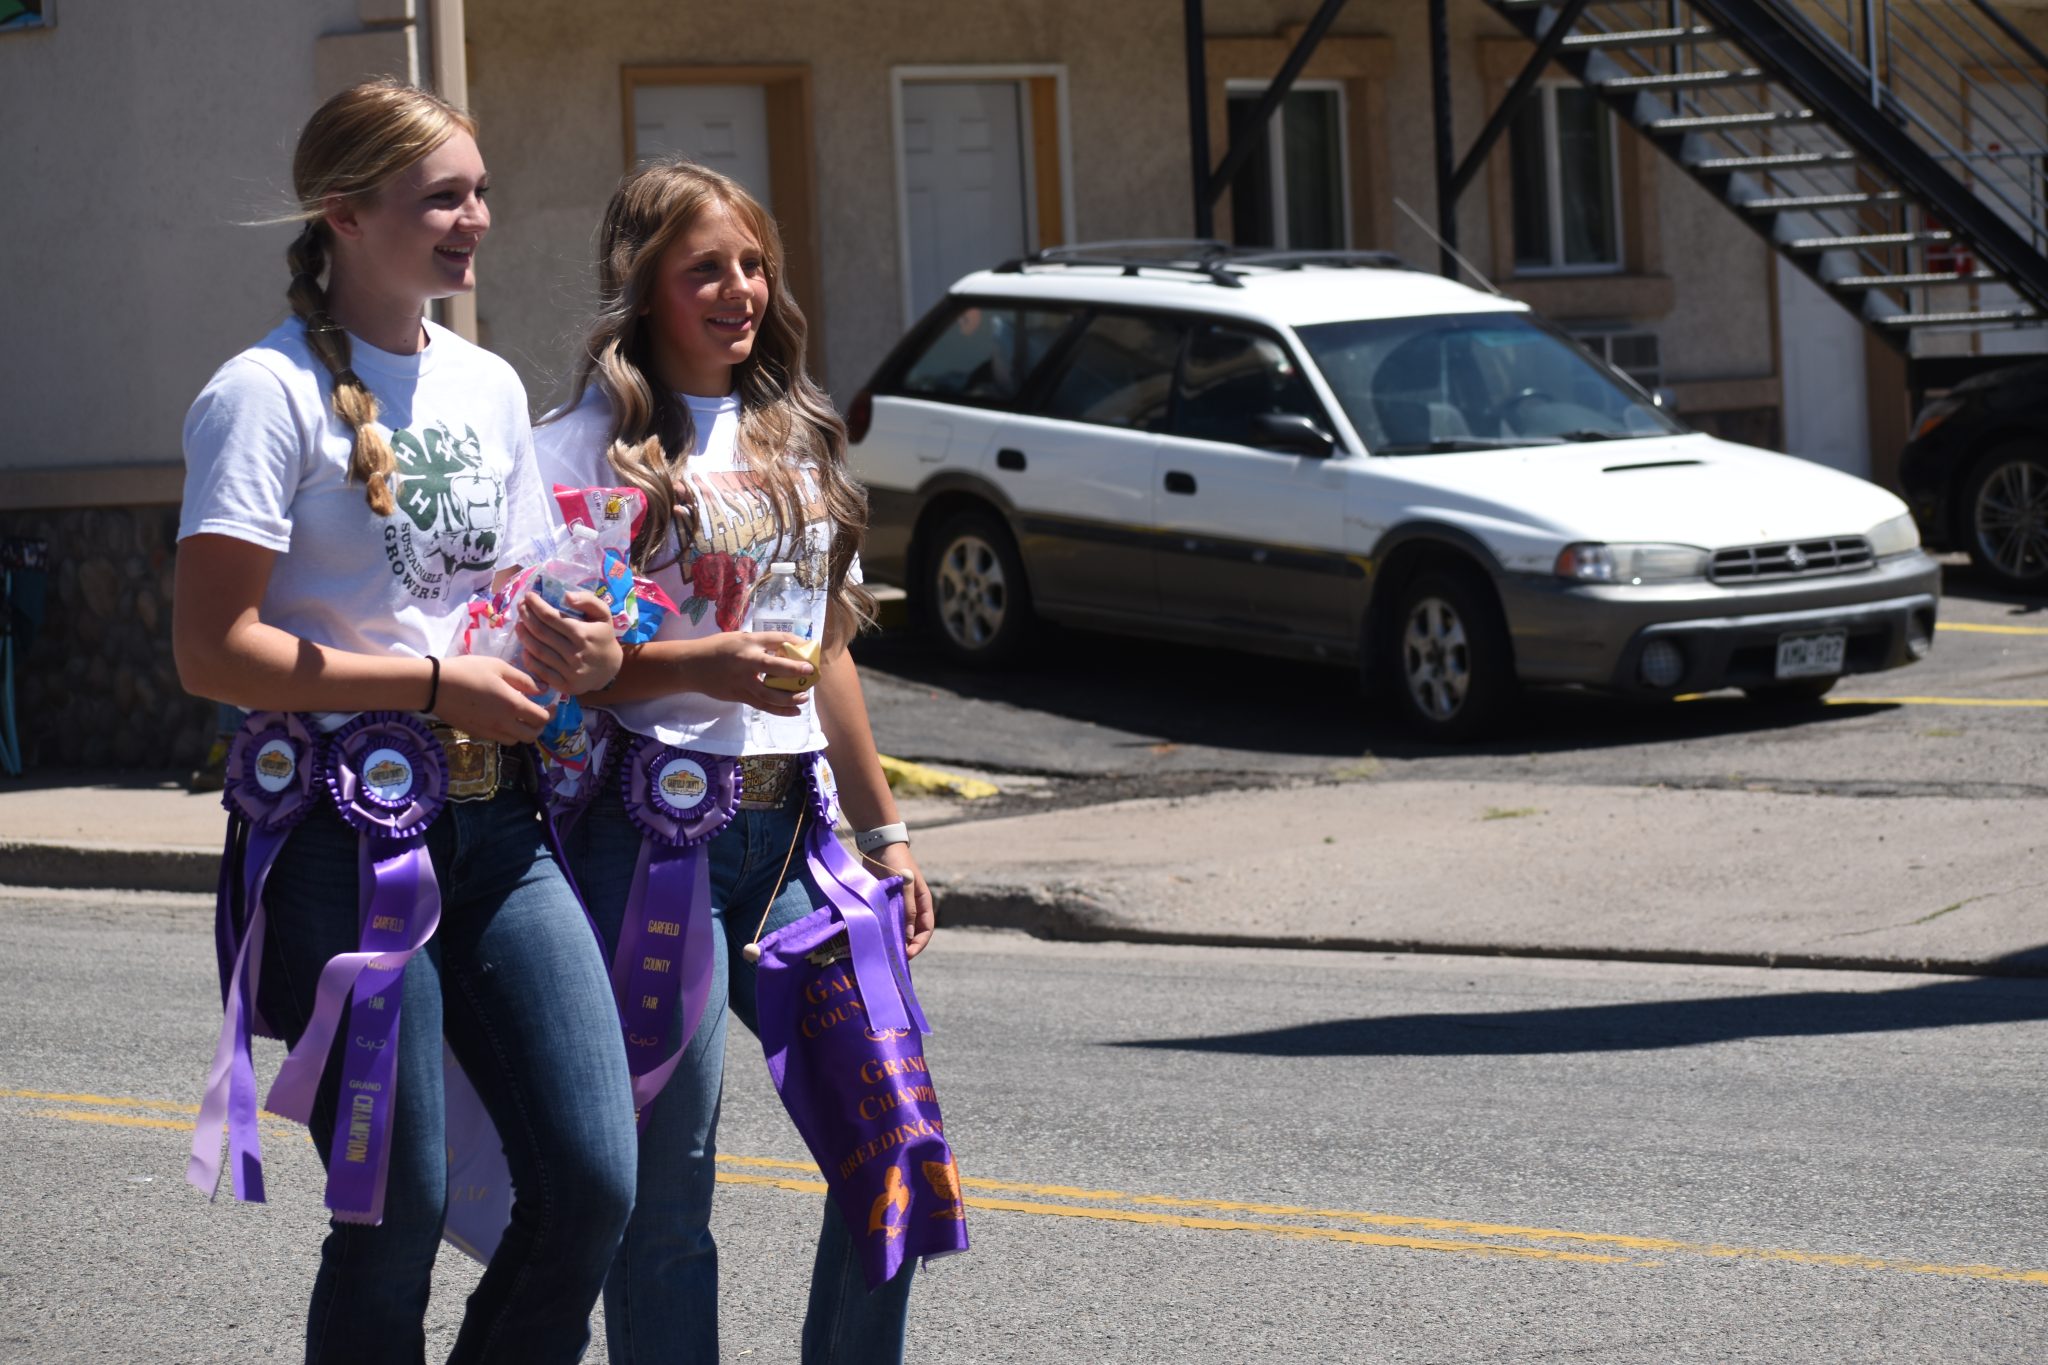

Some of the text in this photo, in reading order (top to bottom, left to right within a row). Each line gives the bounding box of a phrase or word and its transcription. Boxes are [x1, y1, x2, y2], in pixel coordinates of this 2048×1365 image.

[395, 441, 417, 467] H
[408, 487, 432, 516] H
[384, 524, 441, 600] GROWERS
[401, 522, 443, 584] SUSTAINABLE
[372, 914, 405, 933] GARFIELD
[647, 919, 680, 937] GARFIELD
[643, 956, 671, 974] COUNTY
[368, 995, 385, 1010] FAIR
[642, 995, 659, 1010] FAIR
[801, 1000, 864, 1038] COUN
[349, 1079, 382, 1092] GRAND
[345, 1094, 374, 1164] CHAMPION
